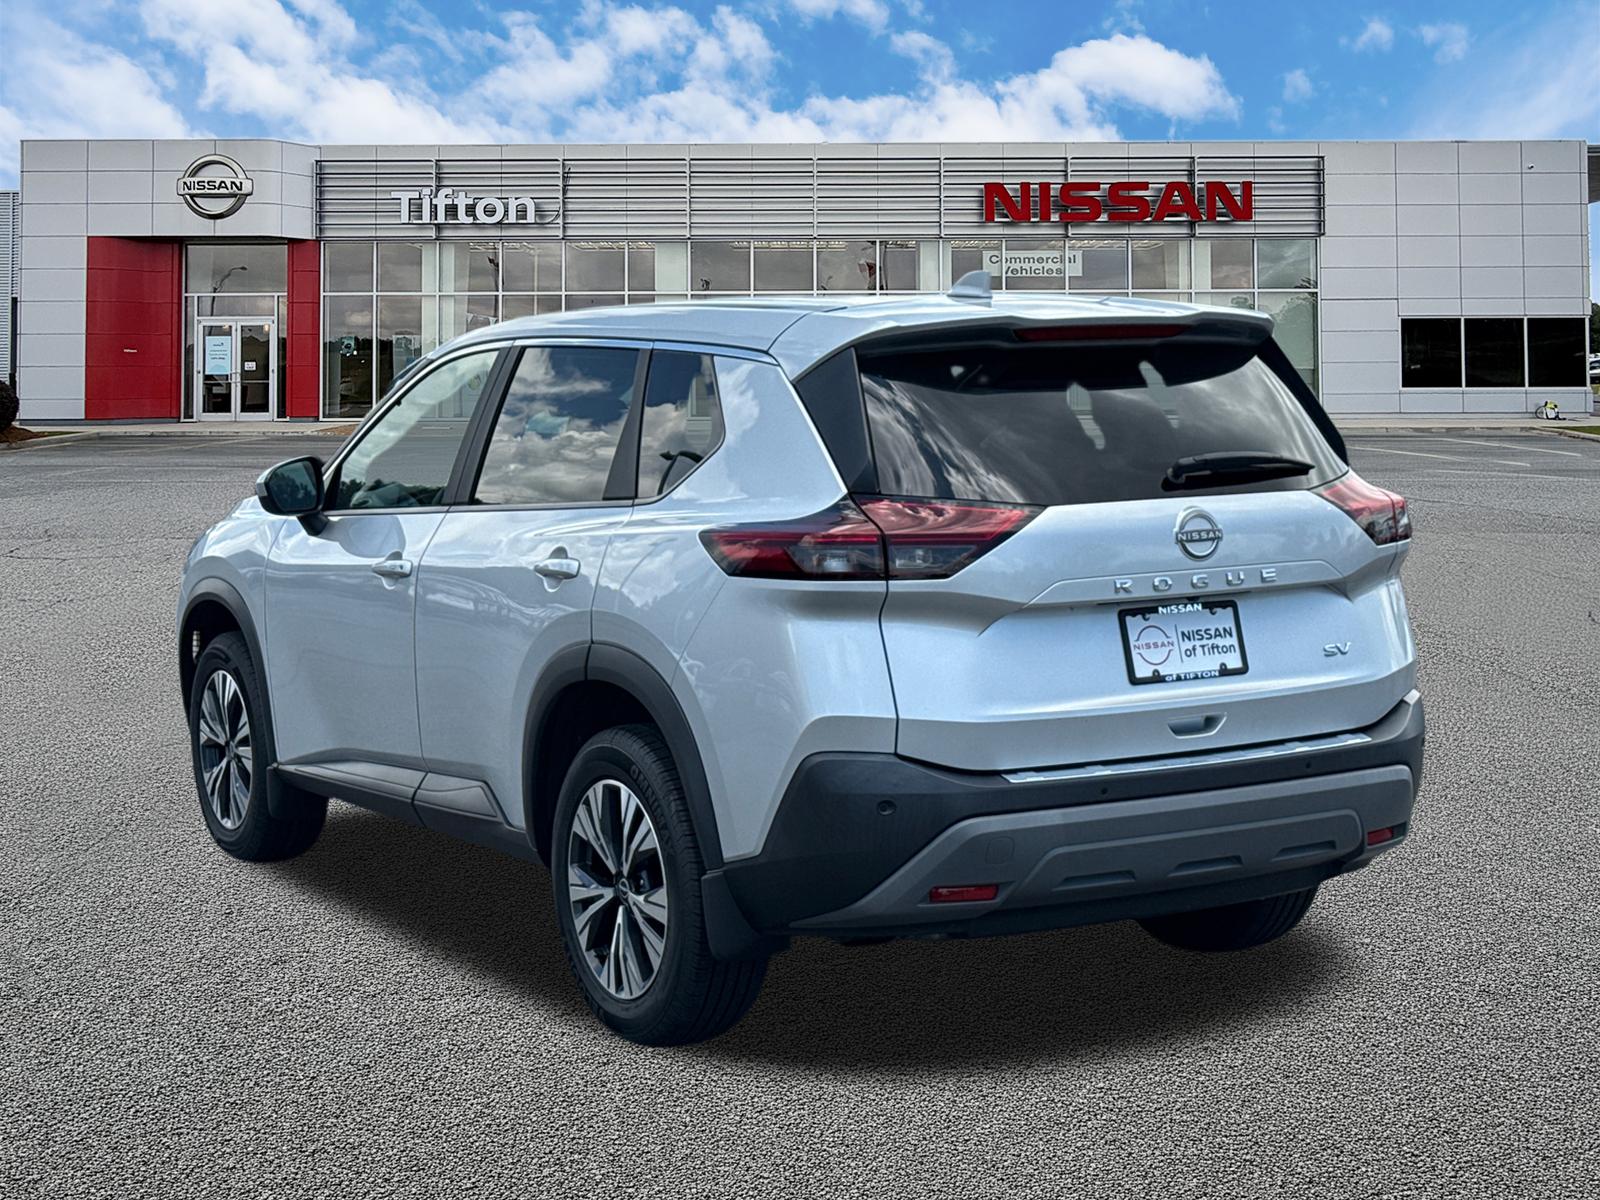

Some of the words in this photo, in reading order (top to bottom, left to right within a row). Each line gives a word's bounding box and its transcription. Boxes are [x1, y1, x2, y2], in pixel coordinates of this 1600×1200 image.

[182, 180, 243, 191] NISSAN
[391, 188, 535, 224] Tifton
[983, 181, 1253, 222] NISSAN
[1177, 530, 1222, 541] NISSAN
[1113, 567, 1278, 594] ROGUE
[1158, 602, 1202, 615] NISSAN
[1180, 626, 1234, 643] NISSAN
[1133, 640, 1175, 651] NISSAN
[1184, 645, 1198, 659] of
[1199, 642, 1237, 657] Tifton
[1322, 641, 1352, 658] SV
[1164, 673, 1178, 682] of
[1179, 669, 1220, 680] TIFTON
